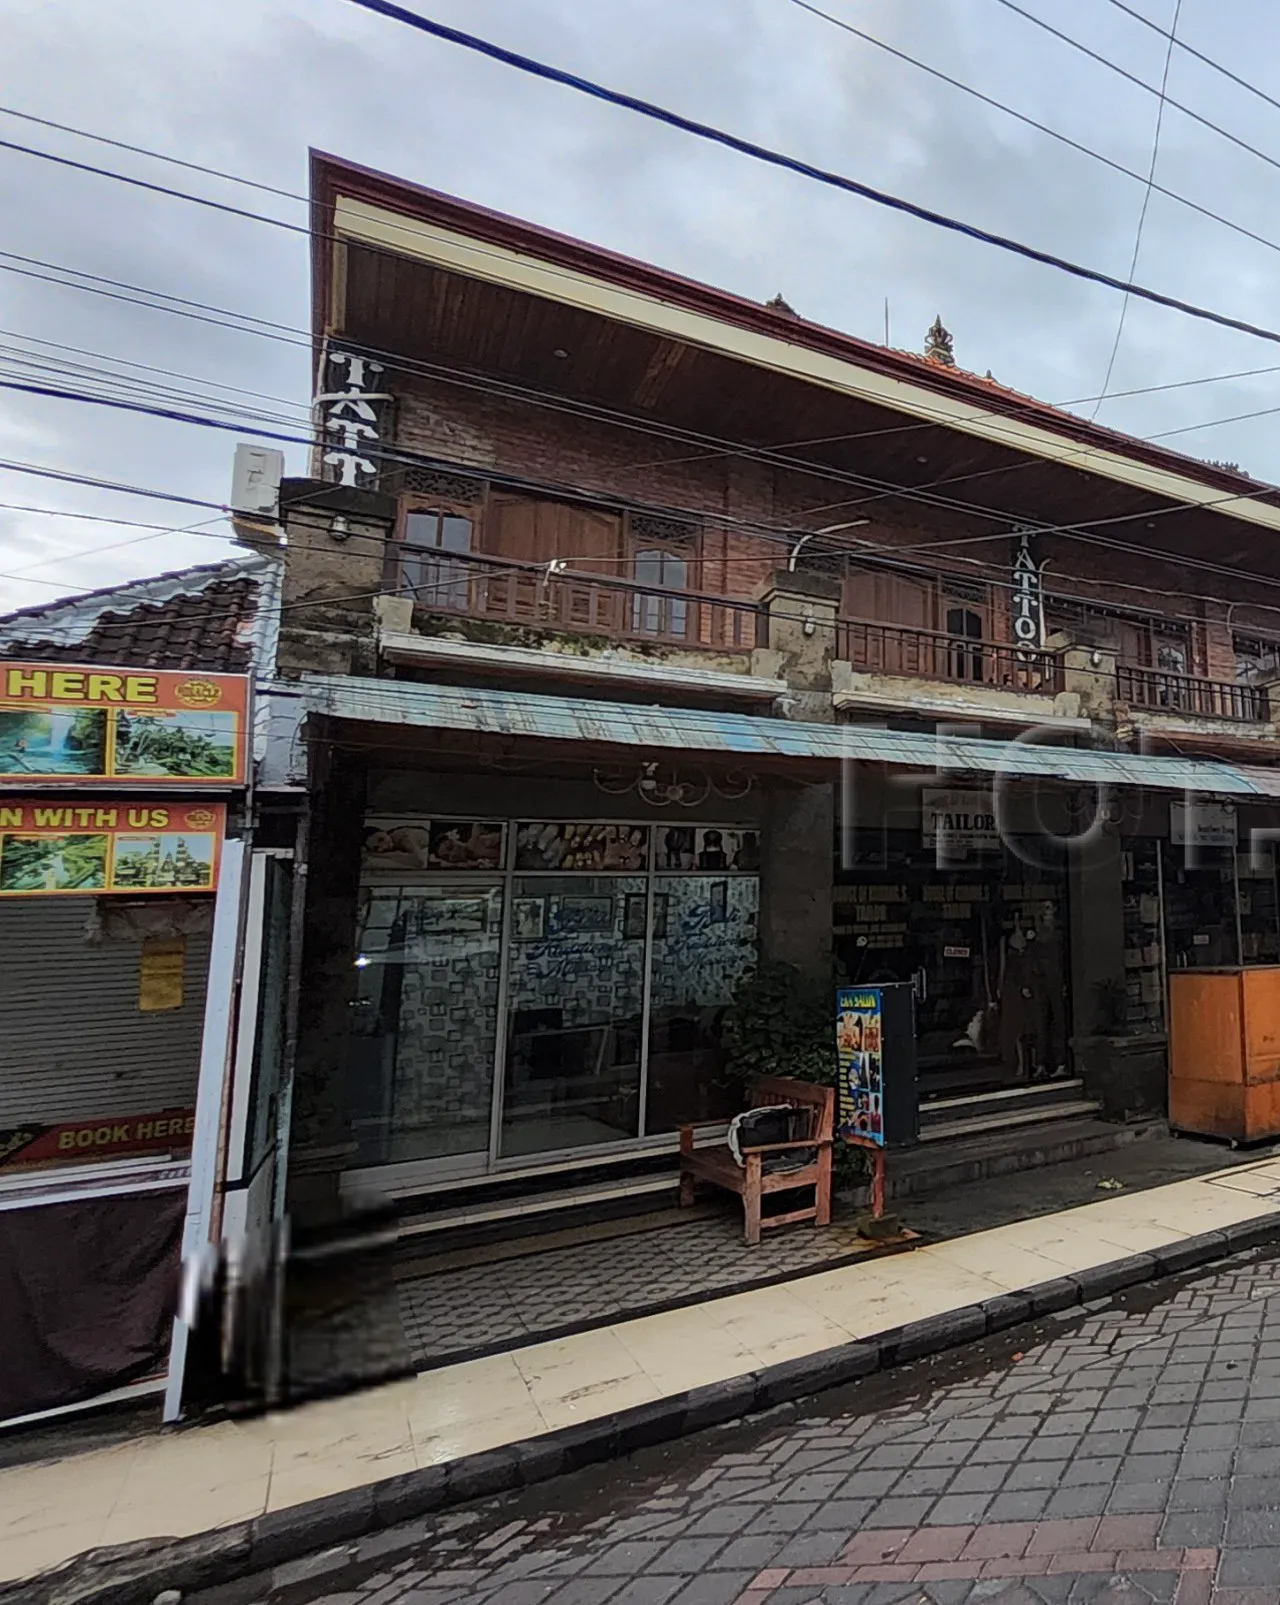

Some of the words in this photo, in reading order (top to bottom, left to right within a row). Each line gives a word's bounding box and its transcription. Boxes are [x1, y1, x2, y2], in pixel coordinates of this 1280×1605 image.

[7, 669, 158, 702] HERE
[33, 807, 118, 827] WITH
[128, 808, 169, 828] US
[931, 813, 996, 831] TAILOR
[58, 1124, 130, 1149] BOOK
[136, 1116, 196, 1140] HERE
